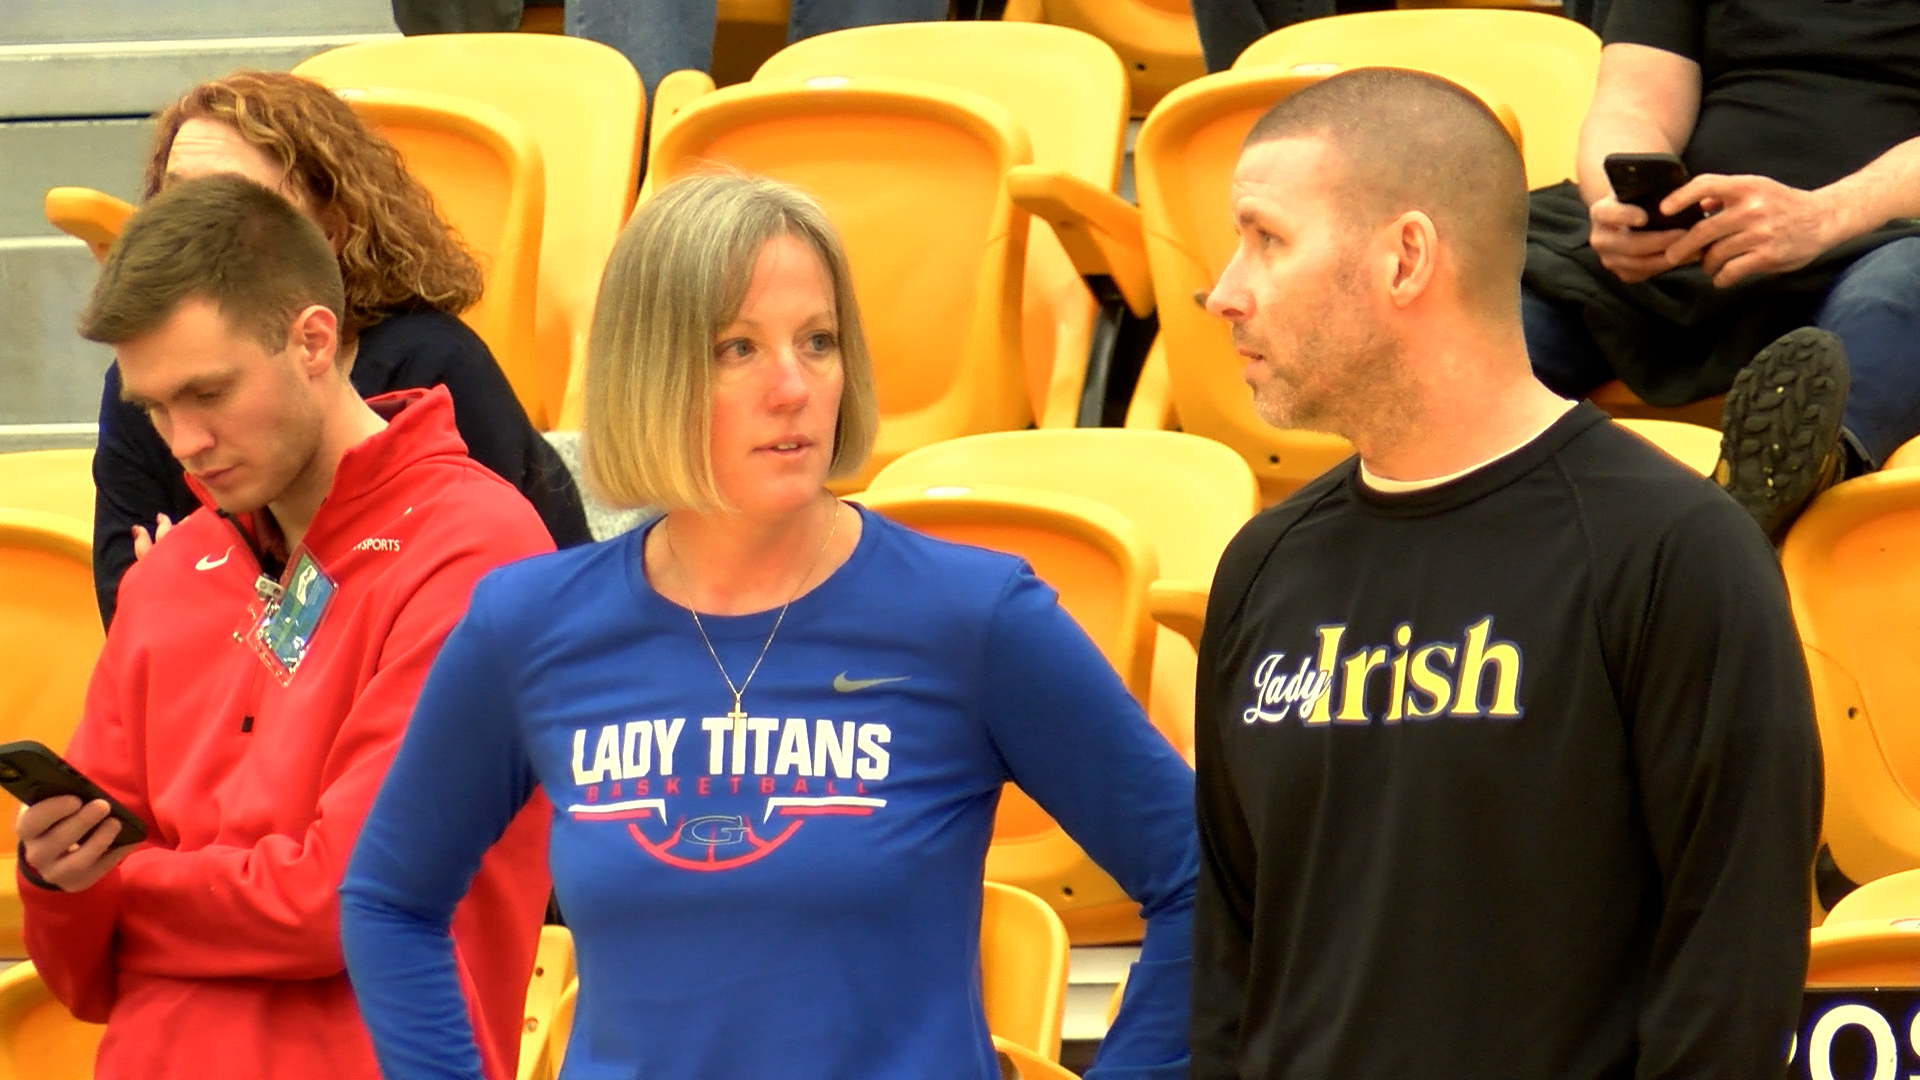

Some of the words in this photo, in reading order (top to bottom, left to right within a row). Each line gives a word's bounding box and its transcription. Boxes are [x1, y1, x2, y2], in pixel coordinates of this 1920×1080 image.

[1243, 653, 1331, 723] Lady
[1307, 616, 1523, 726] Irish
[572, 718, 686, 785] LADY
[702, 717, 892, 780] TITANS
[586, 777, 869, 803] BASKETBALL
